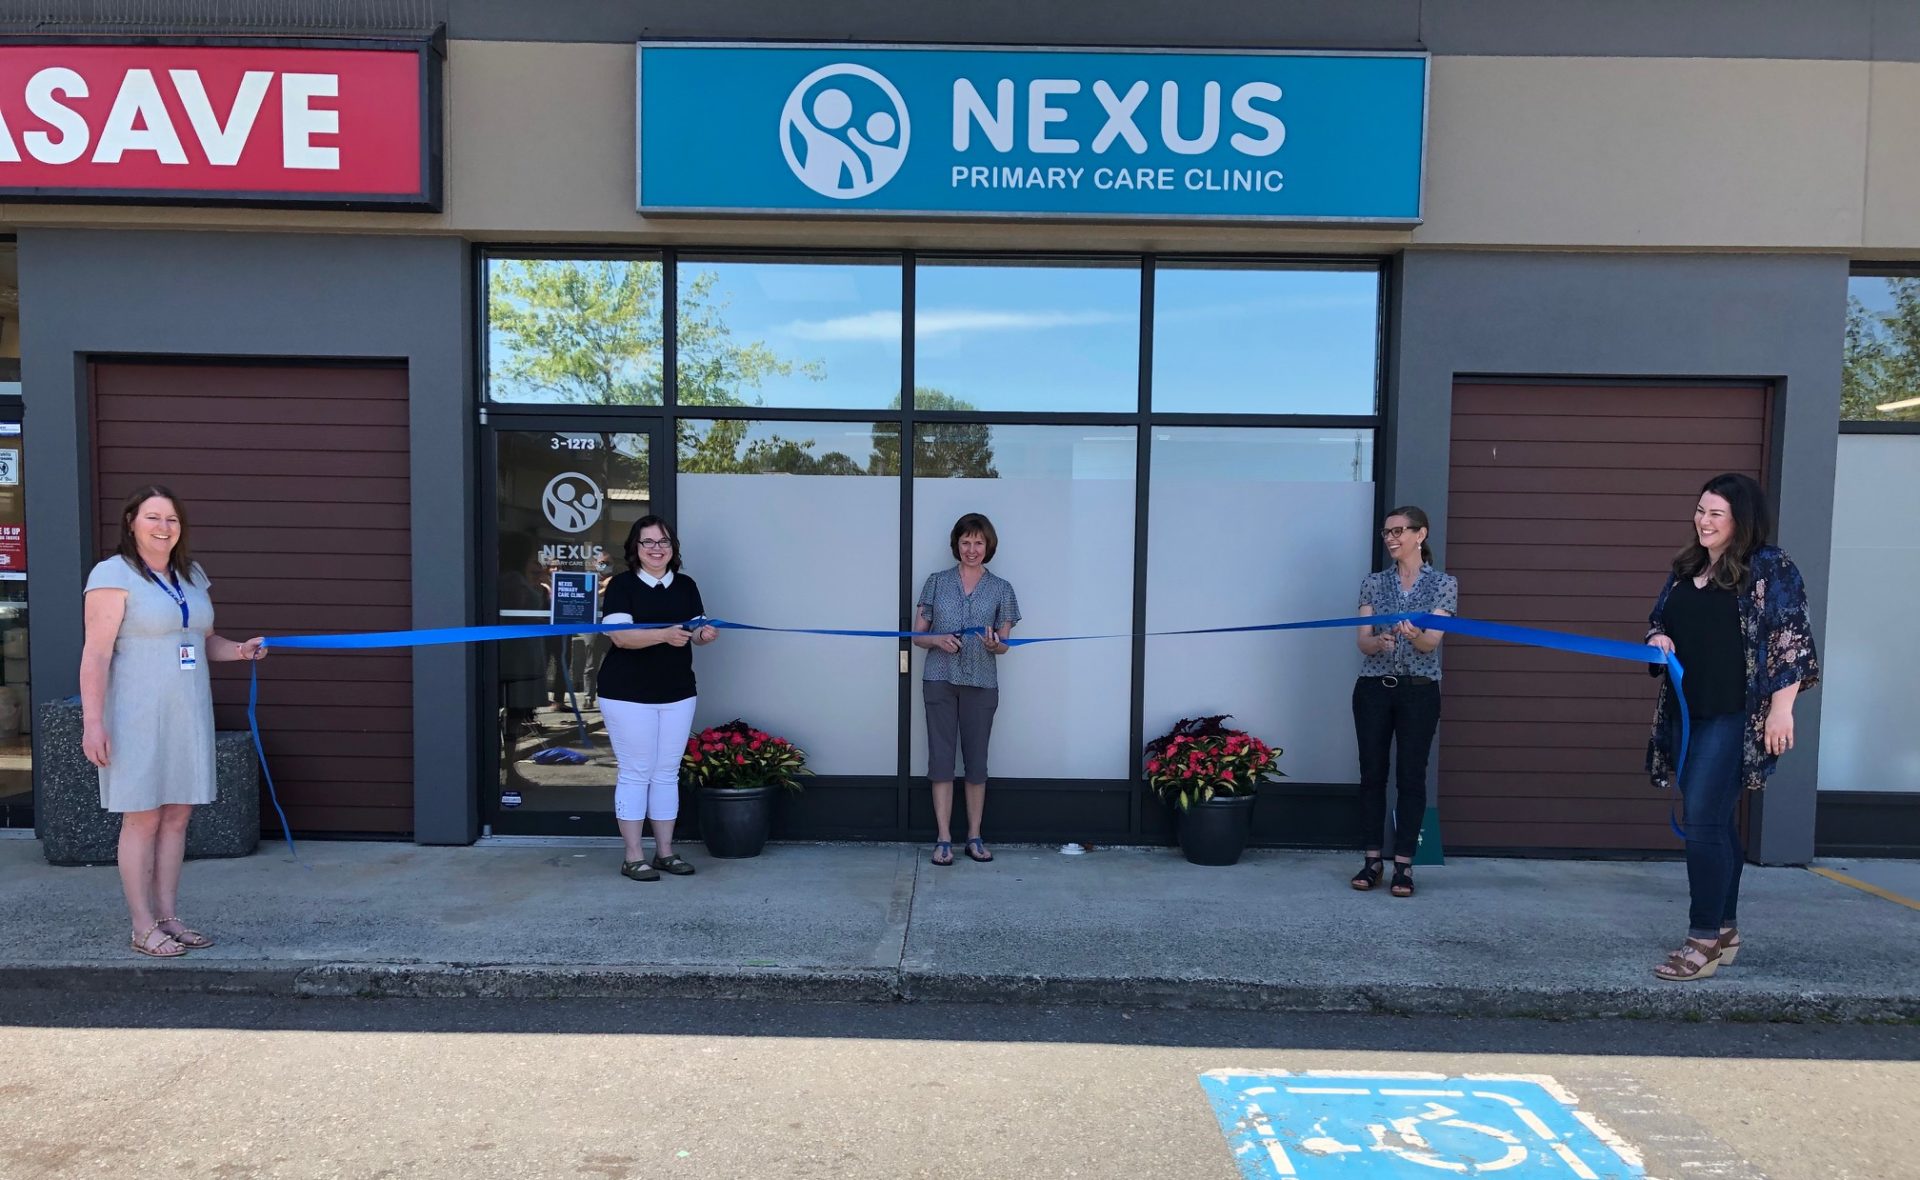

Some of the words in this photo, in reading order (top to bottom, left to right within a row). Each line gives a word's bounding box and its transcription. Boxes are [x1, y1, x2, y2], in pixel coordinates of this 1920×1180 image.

[0, 67, 340, 170] SAVE
[953, 78, 1286, 157] NEXUS
[952, 166, 1085, 189] PRIMARY
[1093, 167, 1175, 190] CARE
[1184, 168, 1284, 192] CLINIC
[551, 438, 595, 450] 3-1273
[543, 544, 603, 559] NEXUS
